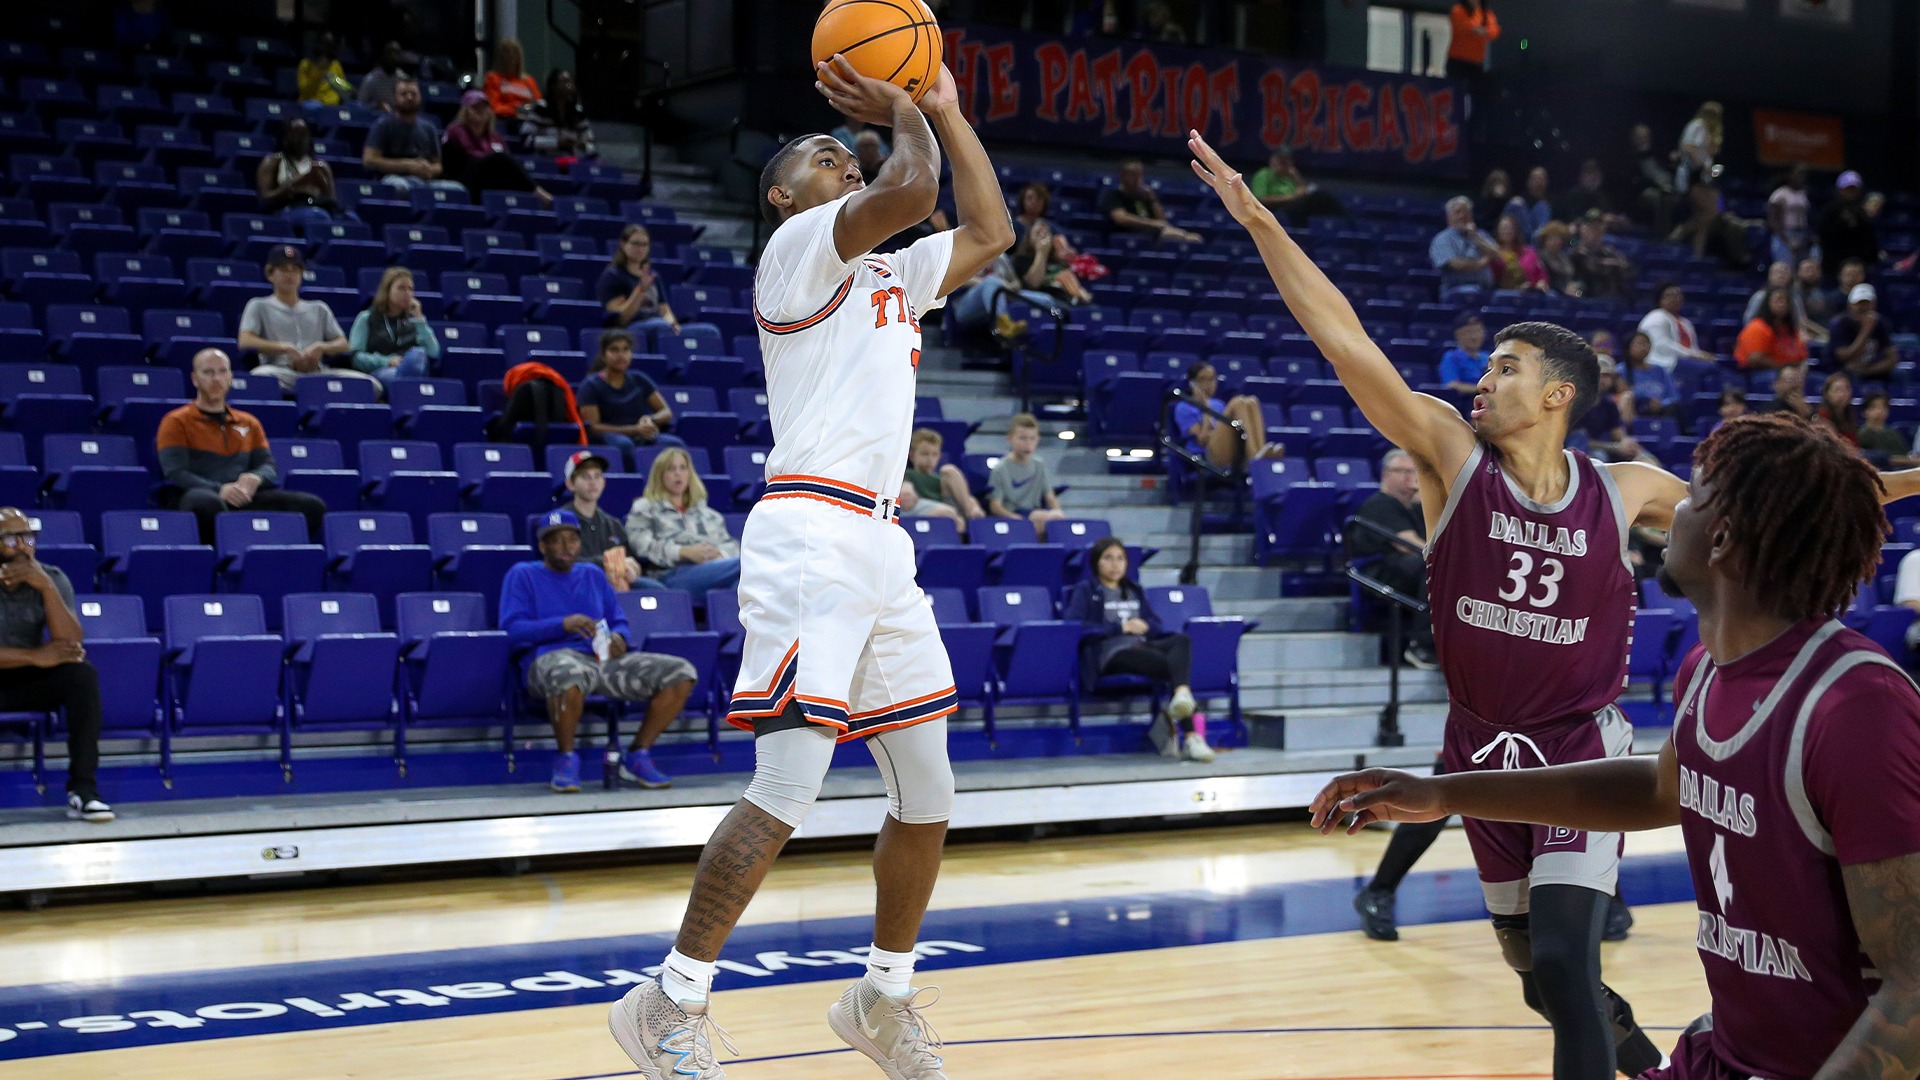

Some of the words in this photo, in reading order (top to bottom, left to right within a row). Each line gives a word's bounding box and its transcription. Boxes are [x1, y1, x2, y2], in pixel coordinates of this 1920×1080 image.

[942, 28, 1020, 128] HE
[1034, 41, 1241, 147] PATRIOT
[1258, 68, 1461, 163] BRIGADE
[871, 286, 922, 333] TYL
[1488, 510, 1588, 557] DALLAS
[1498, 550, 1565, 608] 33
[1456, 595, 1590, 645] CHRISTIAN
[1679, 764, 1757, 838] DALLAS
[1708, 832, 1734, 916] 4
[1696, 909, 1813, 983] RISTIAN
[0, 939, 986, 1044] utylrpatriots.
